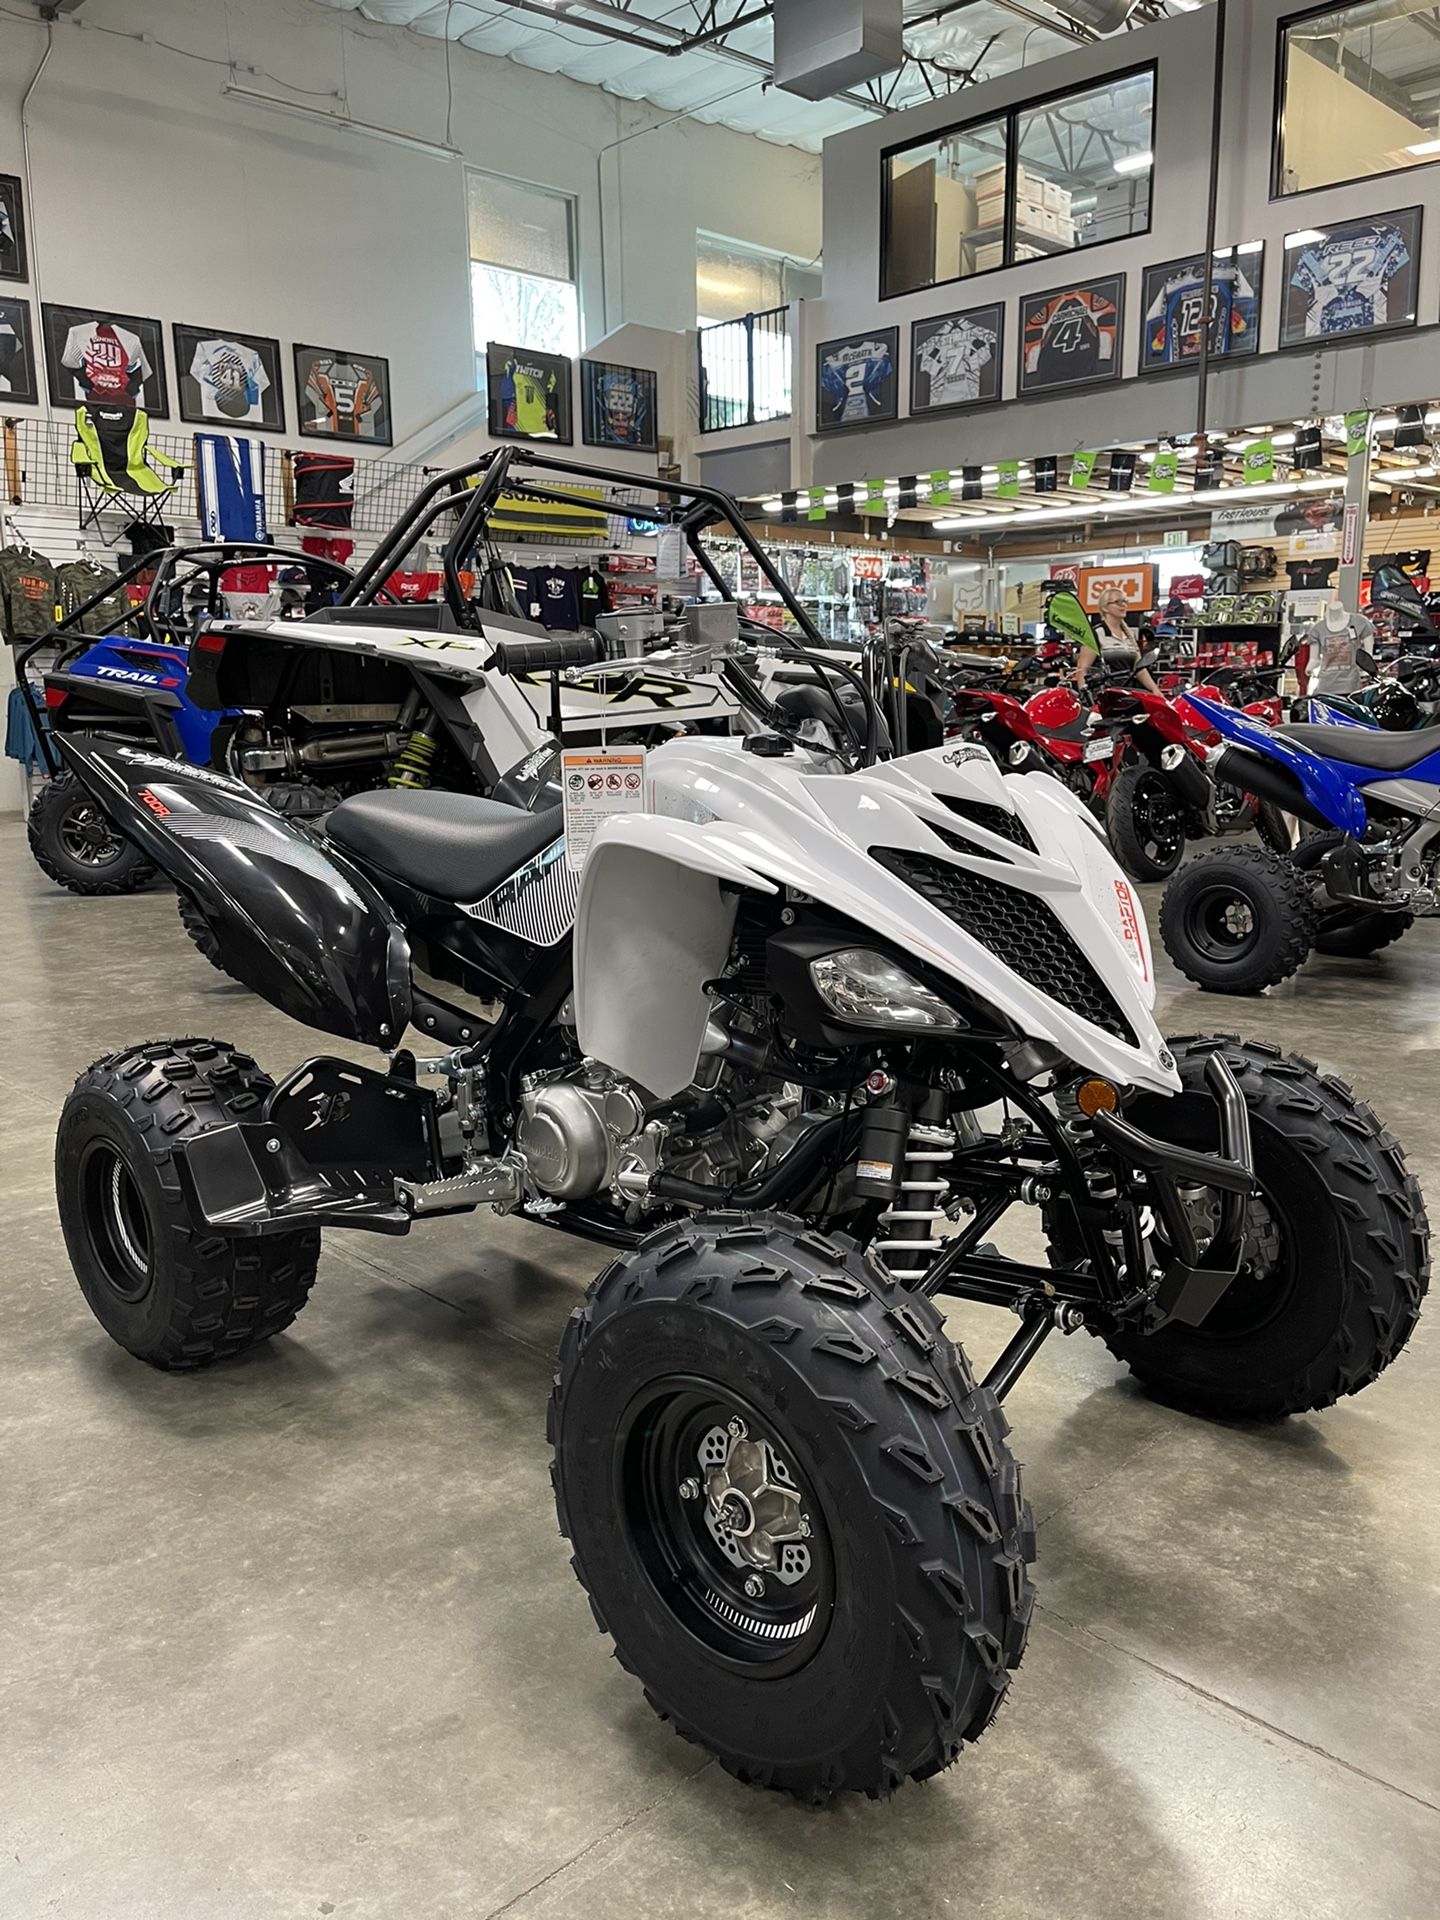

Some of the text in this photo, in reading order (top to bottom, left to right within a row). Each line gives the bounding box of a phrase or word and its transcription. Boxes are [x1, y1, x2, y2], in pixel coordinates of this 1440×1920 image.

[1323, 235, 1381, 256] REED
[1326, 248, 1377, 286] 22
[1052, 317, 1082, 353] 4
[92, 342, 122, 368] 29
[943, 345, 967, 376] 7
[220, 368, 241, 391] 41
[515, 364, 544, 379] TWITCH
[845, 363, 867, 396] 2
[335, 387, 354, 413] 5
[254, 499, 262, 532] YAMAHA
[1218, 506, 1273, 520] FASTHOUSE
[1167, 533, 1183, 546] EXIT
[96, 666, 182, 688] TRAIL S
[138, 788, 171, 817] 700R
[1114, 879, 1137, 941] RAPTOR
